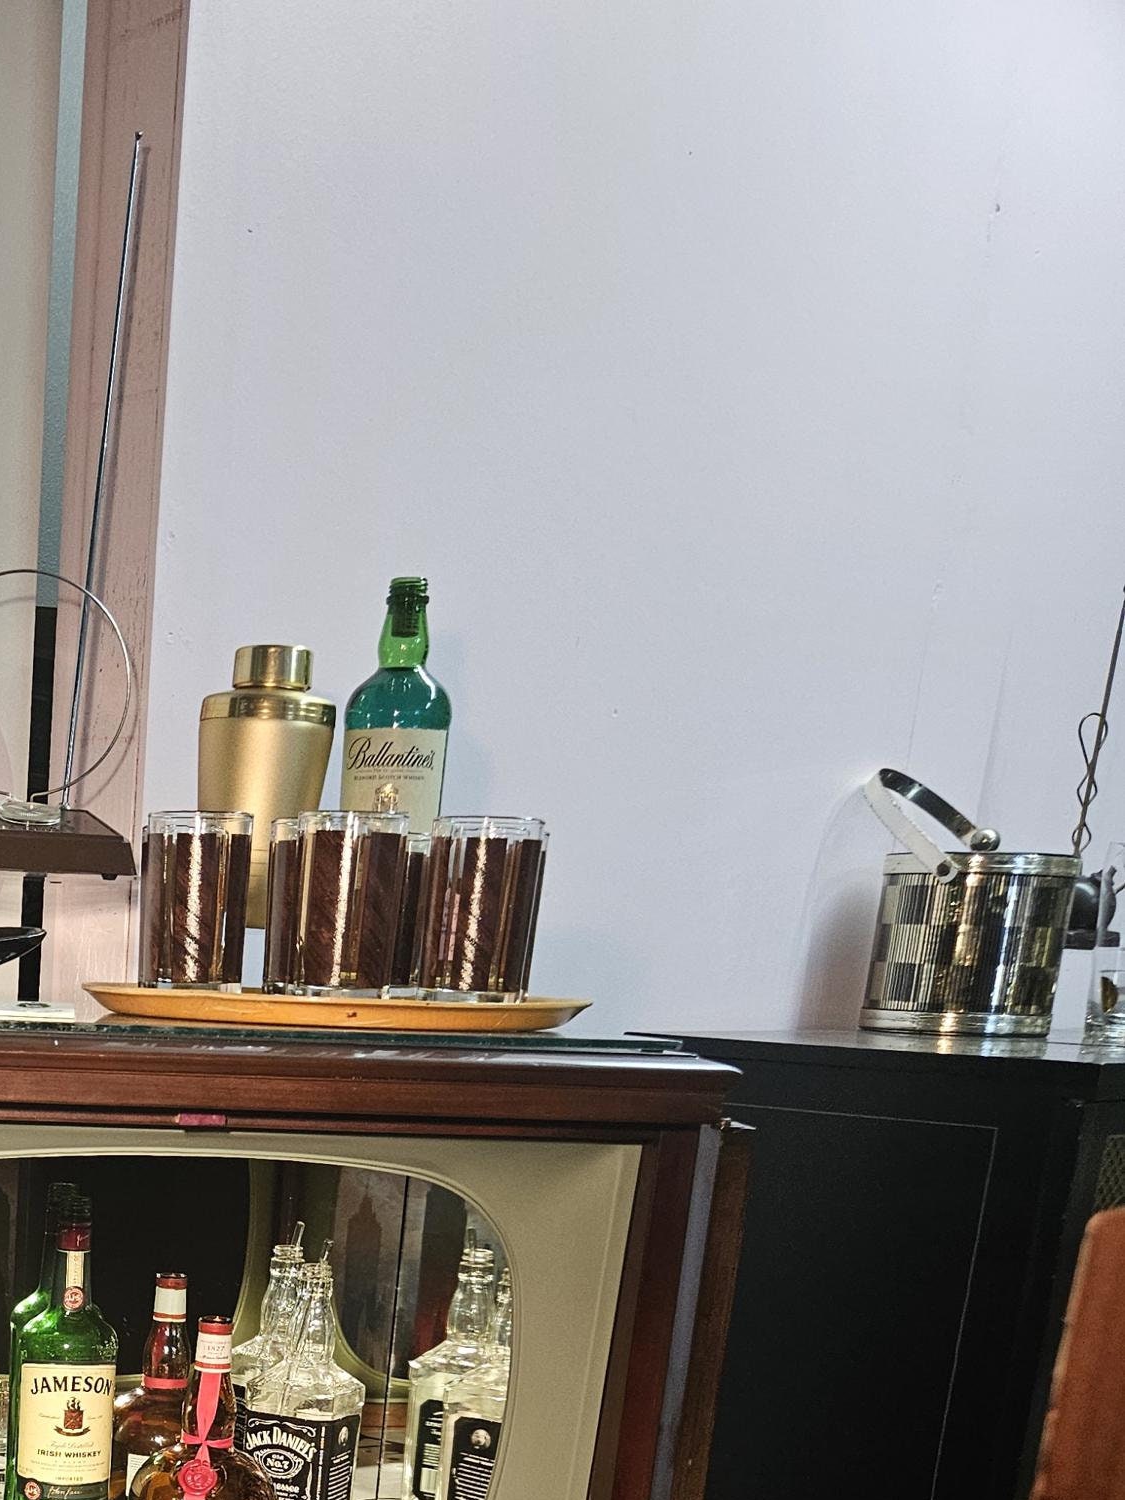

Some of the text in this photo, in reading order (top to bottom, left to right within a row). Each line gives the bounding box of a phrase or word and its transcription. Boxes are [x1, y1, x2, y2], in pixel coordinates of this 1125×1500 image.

[347, 736, 436, 771] Ballantine's
[31, 1376, 113, 1396] JAMESON
[37, 1449, 102, 1458] IRISH WHISKEY
[246, 1430, 271, 1450] JACK
[273, 1426, 318, 1462] DANIEL'S
